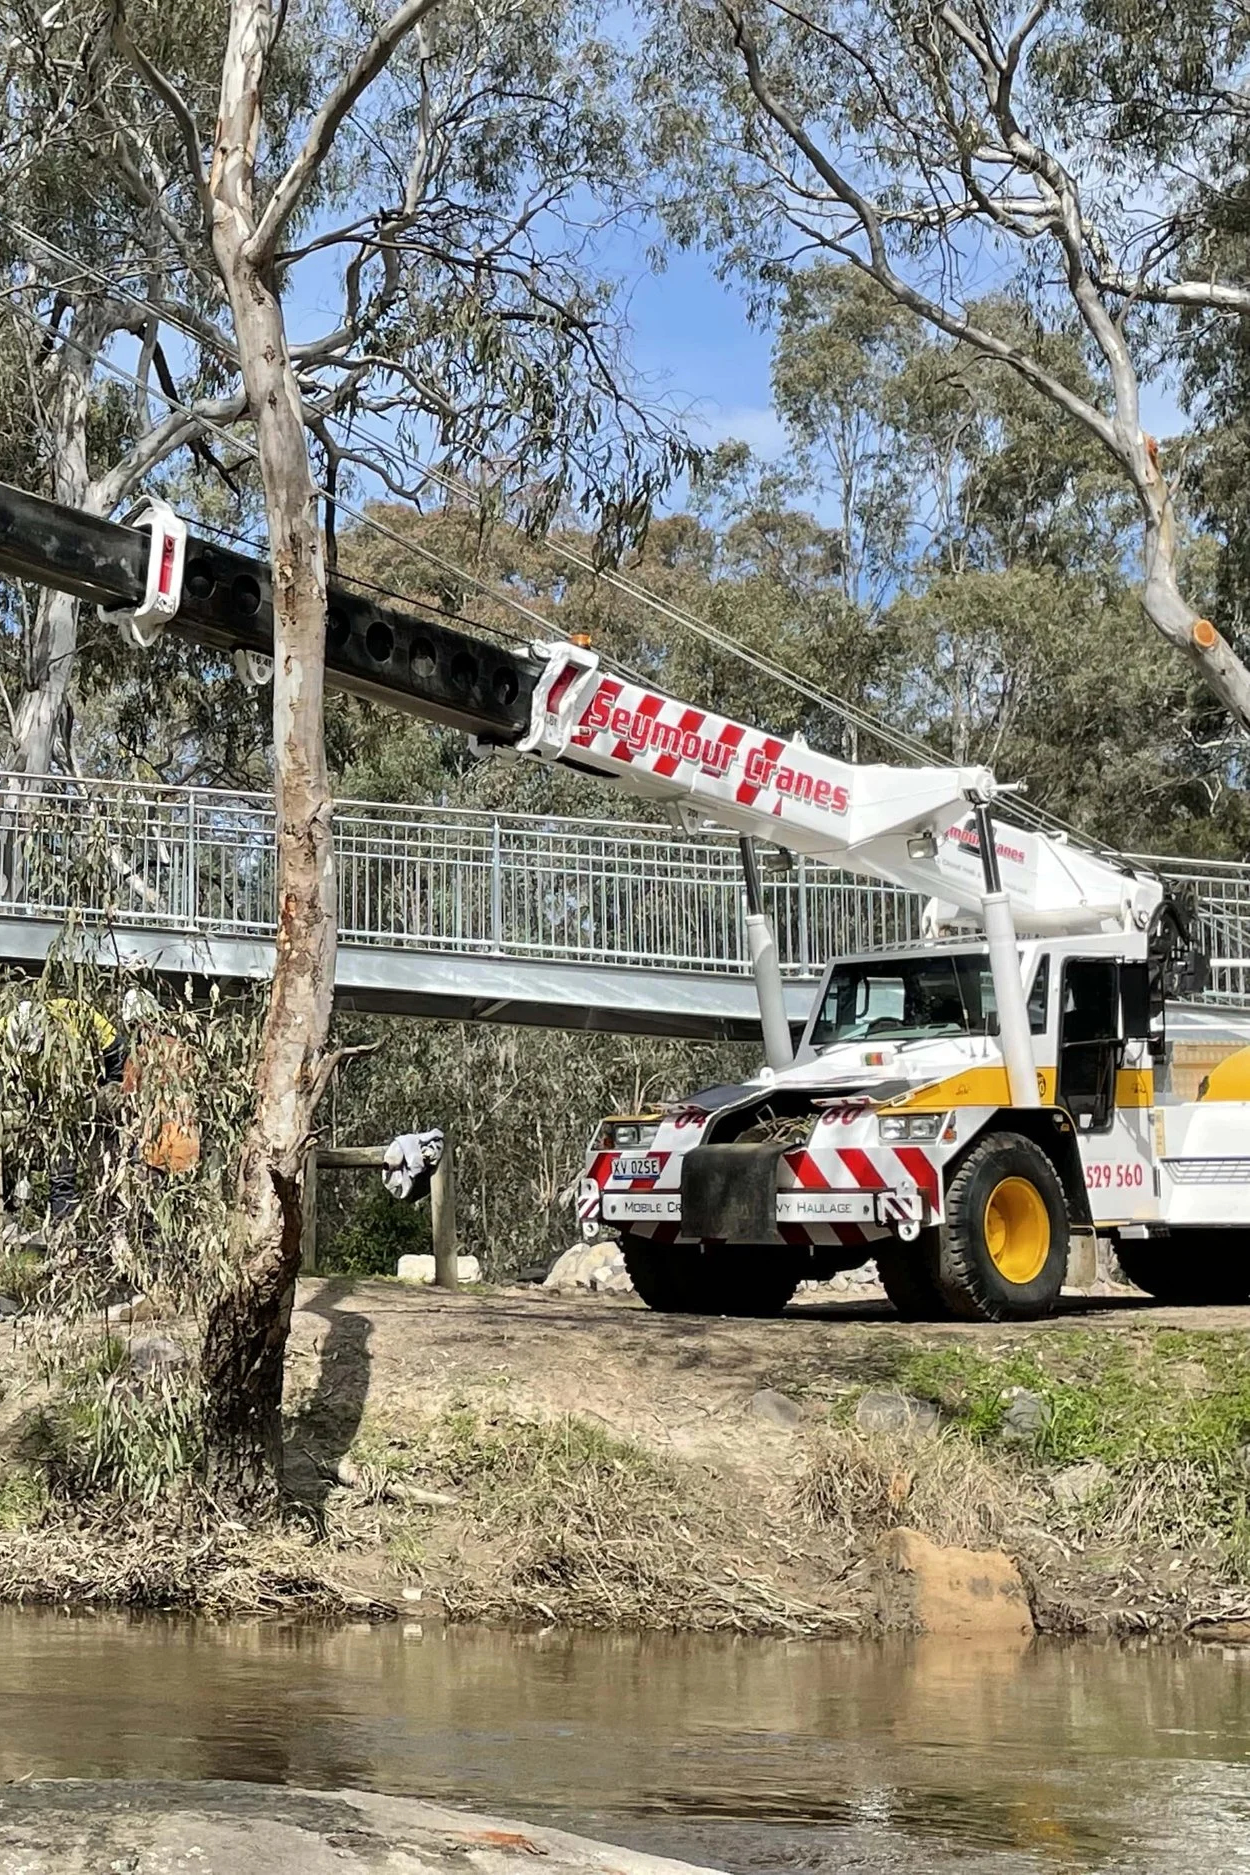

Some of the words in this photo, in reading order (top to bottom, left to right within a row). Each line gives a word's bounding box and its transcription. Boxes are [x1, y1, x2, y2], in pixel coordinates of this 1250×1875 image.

[590, 688, 738, 775] Seymour
[744, 746, 851, 814] Cranes
[613, 1160, 628, 1175] XV
[1086, 1164, 1111, 1188] 529
[1116, 1163, 1143, 1187] 560
